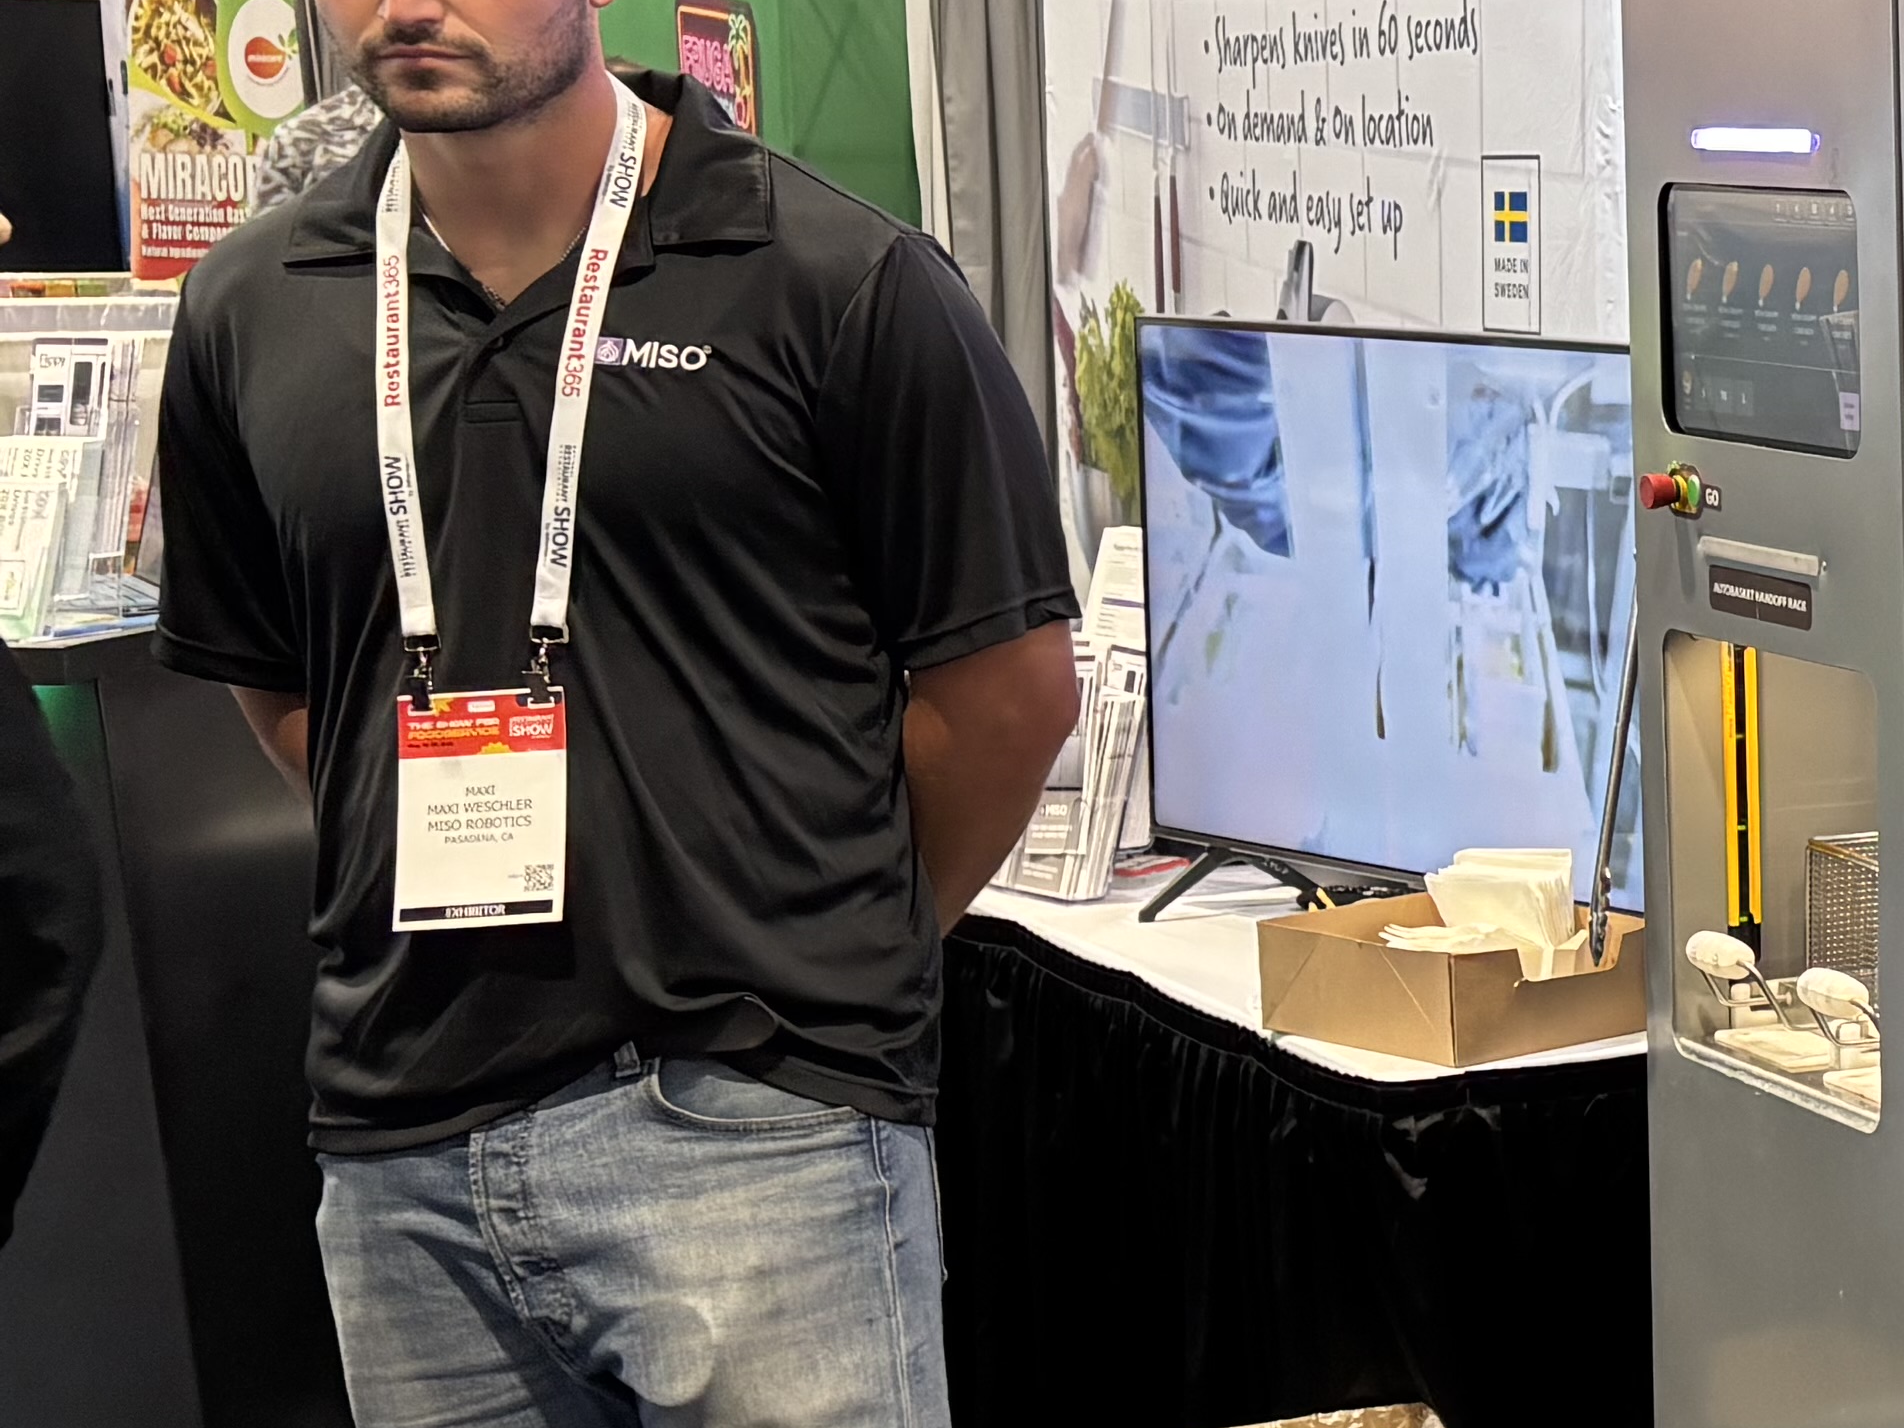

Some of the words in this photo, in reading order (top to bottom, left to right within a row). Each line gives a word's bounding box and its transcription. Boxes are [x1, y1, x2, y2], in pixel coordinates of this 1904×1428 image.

[1214, 15, 1286, 90] Sharpens
[1292, 10, 1346, 67] knives
[1352, 9, 1371, 60] in
[1377, 0, 1399, 57] 60
[1216, 102, 1238, 142] On
[1243, 88, 1308, 145] demand
[1314, 96, 1327, 146] &
[1333, 105, 1356, 148] On
[1362, 93, 1434, 149] location
[608, 153, 637, 209] SHOW
[152, 222, 183, 240] Flavor
[1220, 168, 1262, 225] Quick
[1268, 169, 1300, 224] and
[1306, 189, 1342, 254] easy
[1350, 175, 1375, 236] set
[1381, 199, 1403, 261] up
[1494, 257, 1518, 274] MADE
[1519, 258, 1529, 274] IN
[1494, 282, 1530, 300] SWEDEN
[383, 254, 400, 408] Restaurant365
[561, 248, 609, 399] Restaurant365
[384, 455, 408, 516] SHOW
[1704, 488, 1720, 508] GO
[549, 505, 572, 569] SHOW
[513, 723, 555, 737] SHOW
[427, 819, 462, 832] MISO
[466, 815, 532, 830] ROBOTICS
[463, 798, 533, 813] WESCHLER
